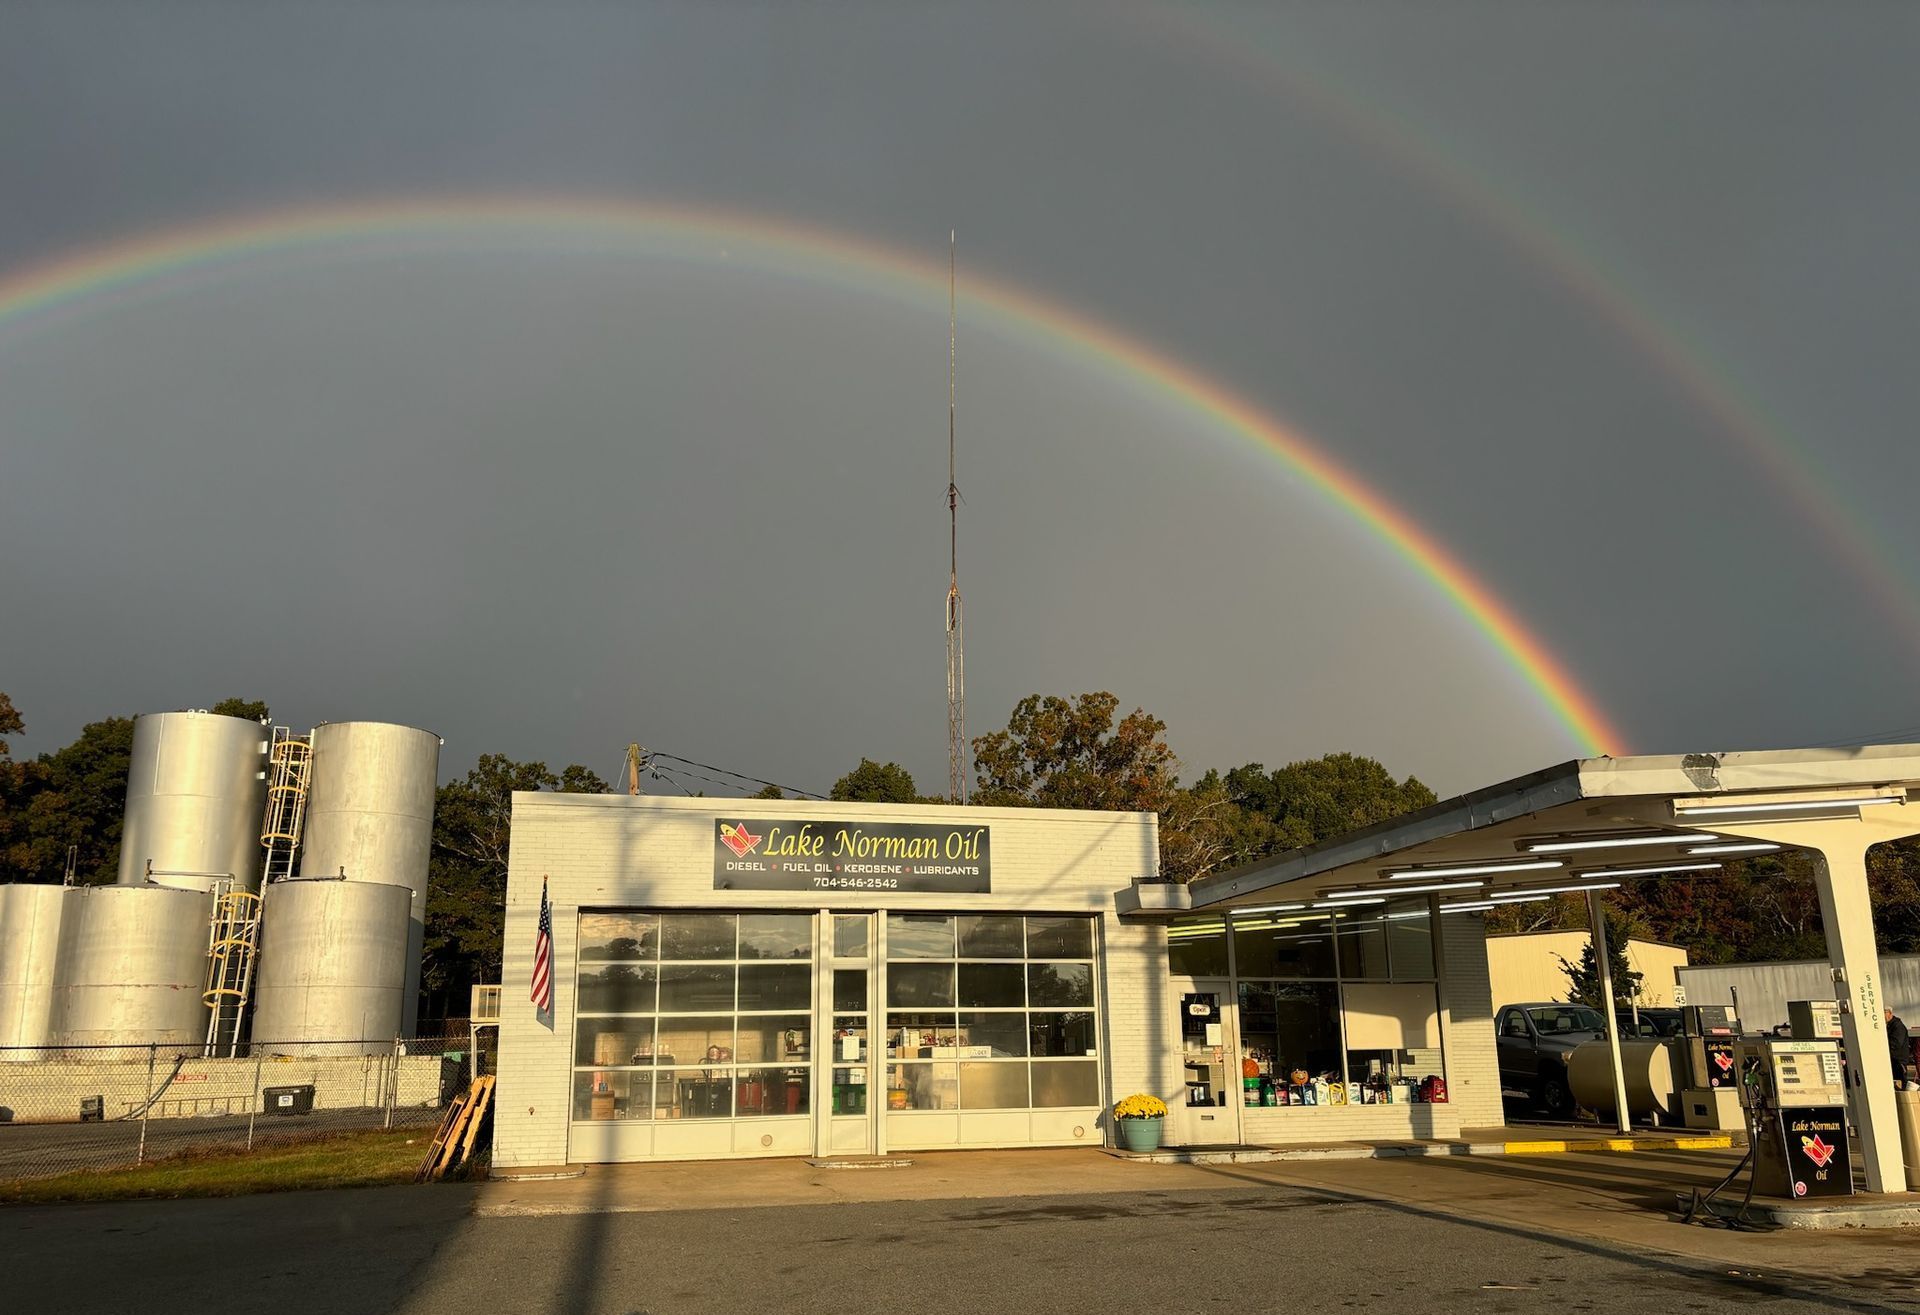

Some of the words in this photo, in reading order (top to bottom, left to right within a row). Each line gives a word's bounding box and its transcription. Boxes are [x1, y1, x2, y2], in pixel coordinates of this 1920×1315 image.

[763, 824, 824, 857] Lake
[832, 829, 939, 859] Norman
[945, 828, 984, 860] Oil
[726, 861, 766, 872] DIESEL
[783, 862, 811, 872] FUEL
[814, 863, 832, 873] OIL
[844, 864, 902, 874] KEROSENE
[913, 865, 979, 875] LUBRICANTS
[813, 877, 898, 888] 704-546-2542
[1675, 996, 1686, 1005] 45
[1859, 986, 1869, 1017] SELF
[1865, 974, 1879, 1030] SERVICE
[1791, 1120, 1809, 1131] Lake
[1810, 1120, 1840, 1131] Norman
[1815, 1169, 1828, 1180] Oil
